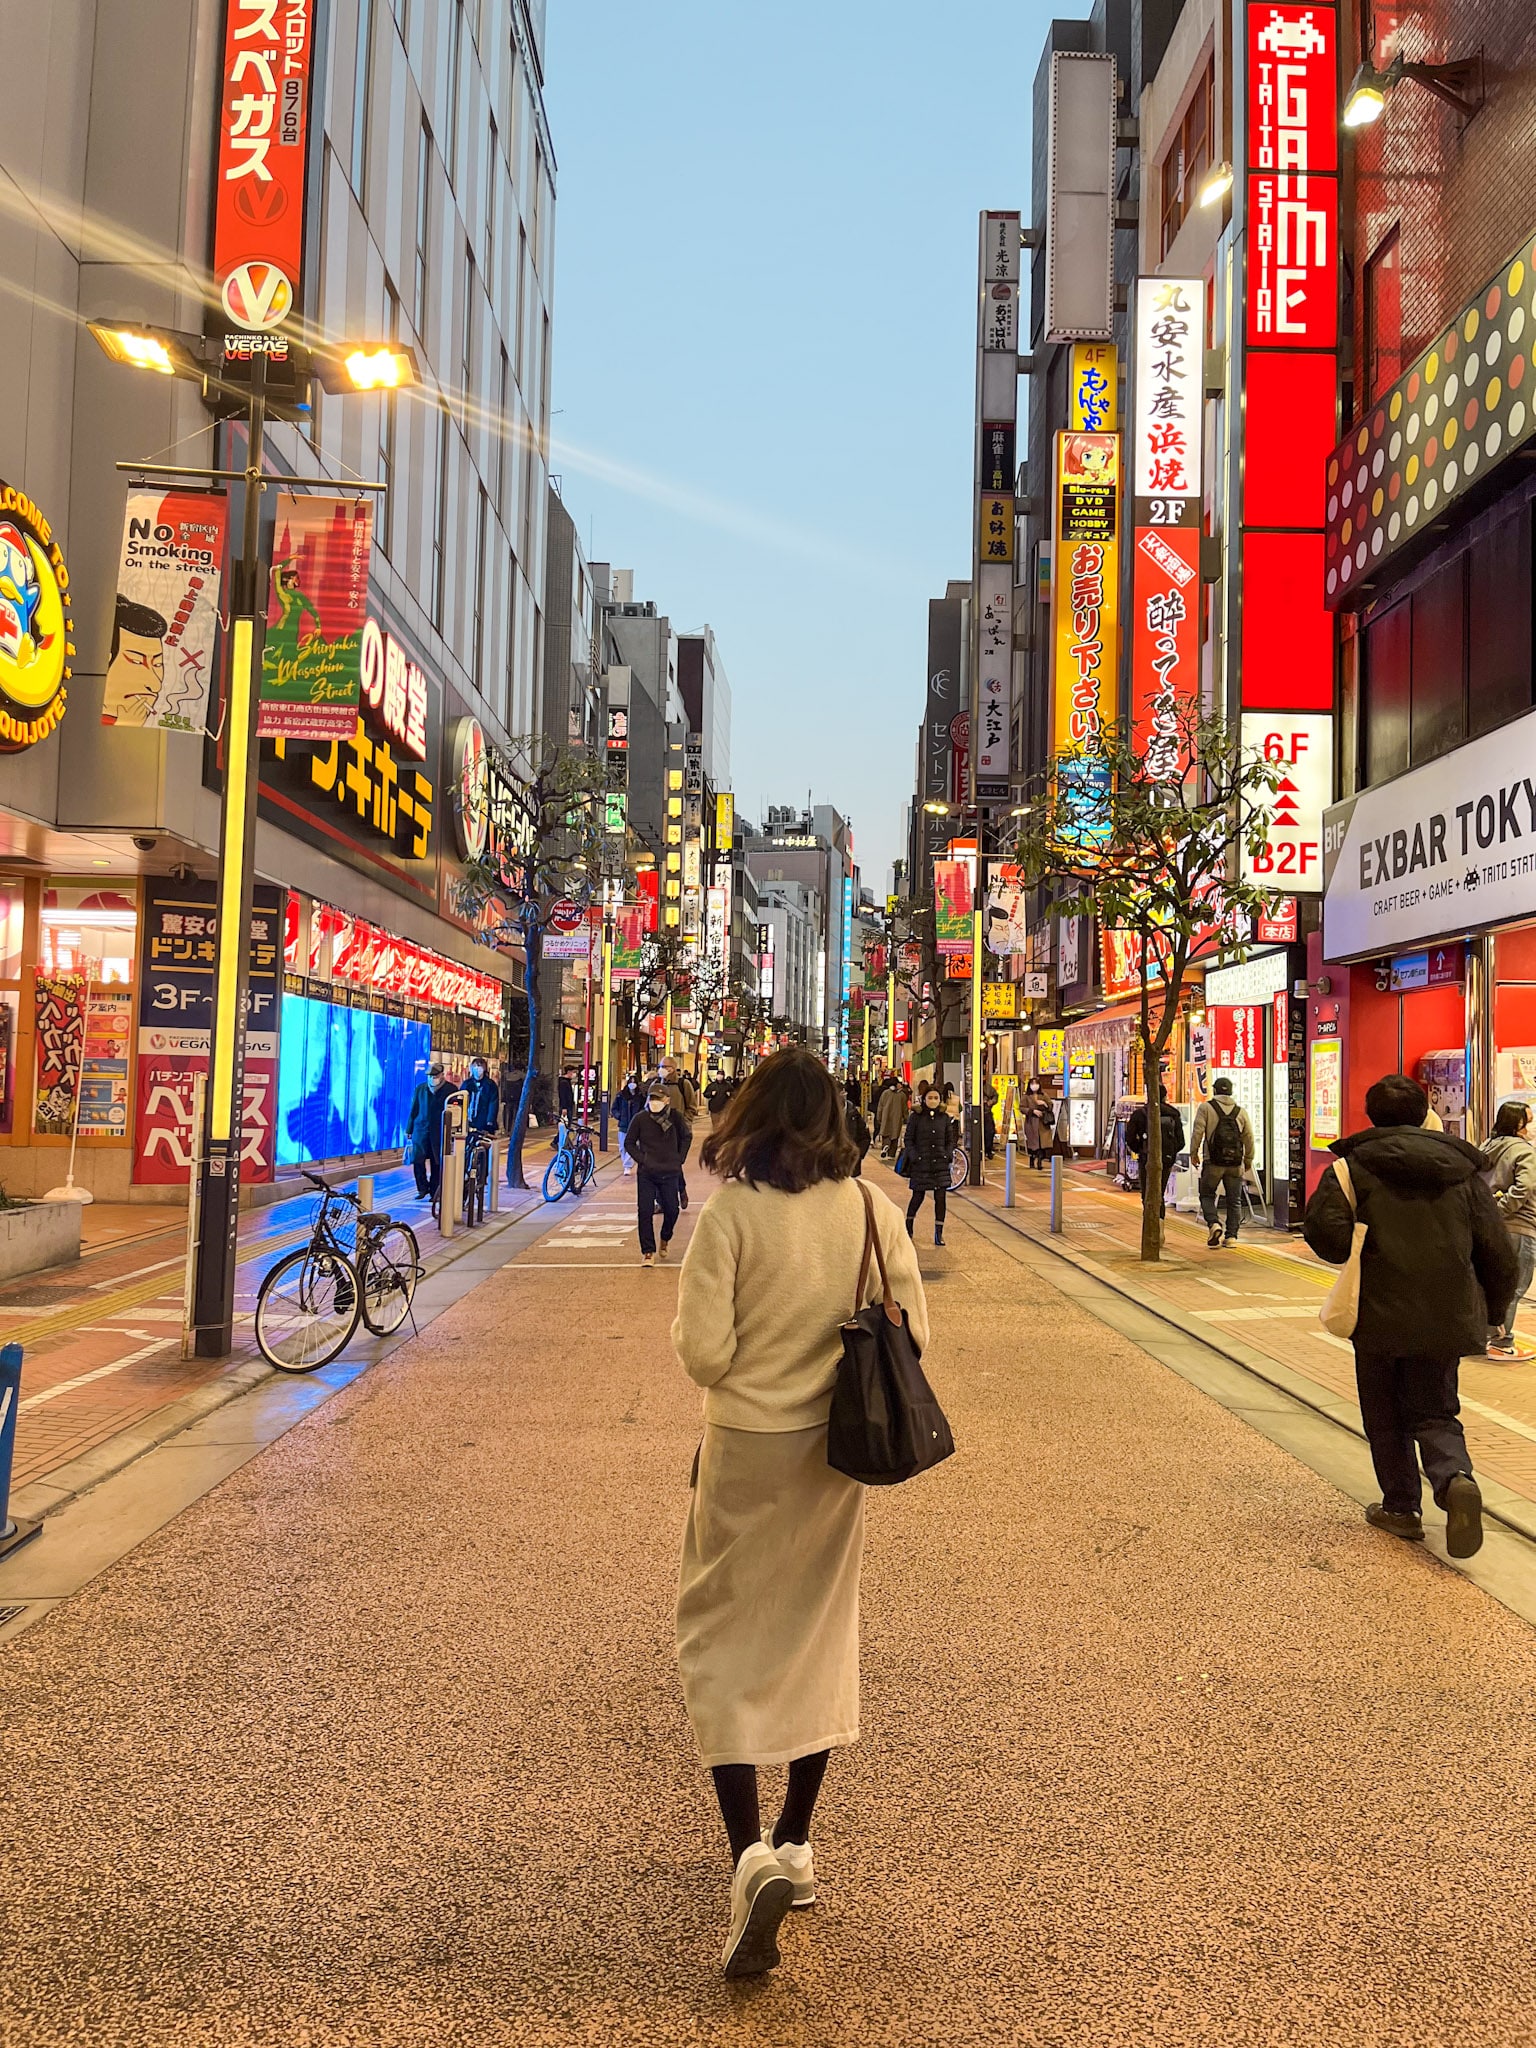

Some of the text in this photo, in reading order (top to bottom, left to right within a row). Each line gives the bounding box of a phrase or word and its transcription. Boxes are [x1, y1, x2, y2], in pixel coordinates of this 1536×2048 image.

[282, 80, 299, 142] 876台
[1257, 63, 1273, 333] TAITO STATION
[1276, 64, 1327, 334] GAME
[224, 340, 288, 352] VEGAS
[1085, 348, 1106, 363] 4F
[992, 431, 1004, 455] 麻雀
[1069, 485, 1110, 496] Blu-ray
[1075, 497, 1104, 506] DVD
[1069, 519, 1109, 529] HOBBY
[1071, 508, 1106, 517] GAME
[1149, 500, 1186, 525] 2F
[129, 517, 174, 541] No
[1068, 530, 1110, 540] フィギュア
[127, 541, 213, 565] Smoking
[125, 558, 217, 576] On the street
[296, 632, 359, 663] Shinjuku
[309, 677, 357, 705] Street
[360, 616, 428, 761] の殿堂
[985, 699, 1002, 749] 大江戸
[1263, 732, 1309, 765] 6F
[1324, 820, 1345, 855] B1F
[1253, 842, 1319, 875] B2F
[1359, 813, 1448, 890] EXBAR
[1373, 895, 1398, 917] CRAFT
[1400, 889, 1421, 909] BEER
[1429, 878, 1454, 900] GAME
[1482, 862, 1507, 886] TAITO
[1264, 926, 1294, 939] 本店
[169, 1039, 211, 1050] VEGA
